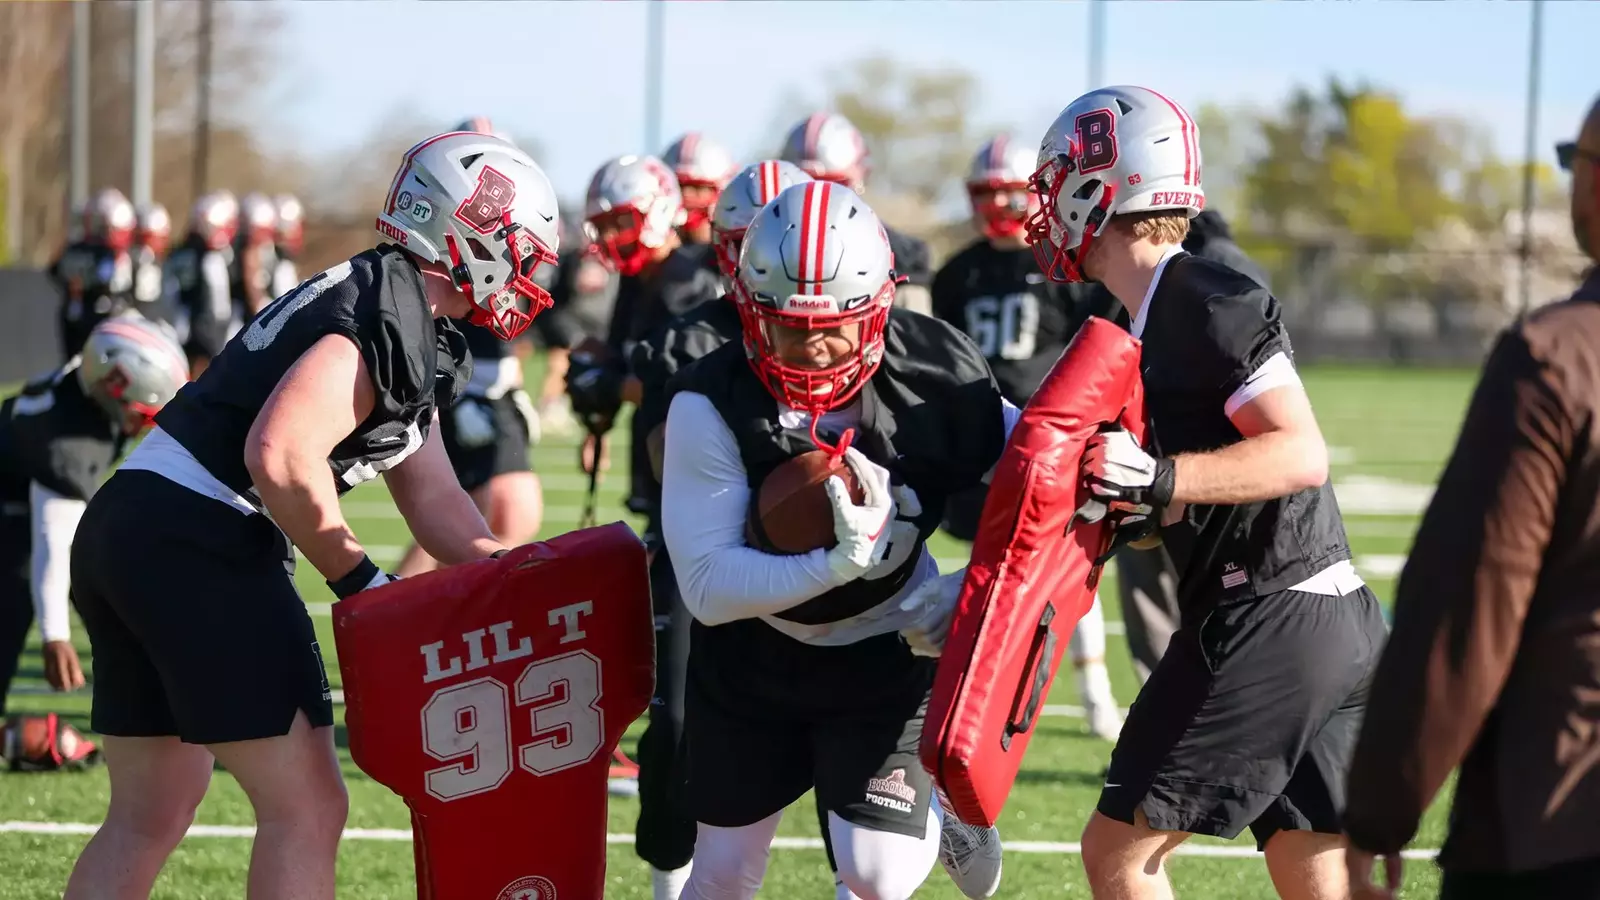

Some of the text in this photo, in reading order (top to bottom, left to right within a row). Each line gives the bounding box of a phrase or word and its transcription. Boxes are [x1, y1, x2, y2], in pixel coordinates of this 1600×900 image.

[1074, 108, 1118, 175] B
[1127, 173, 1142, 186] 63
[412, 203, 431, 219] BT
[453, 164, 516, 236] B
[1149, 191, 1192, 207] EVER
[380, 221, 409, 247] TRUE
[789, 299, 830, 309] Riddell
[965, 293, 1040, 360] 60
[1224, 561, 1238, 572] XL
[419, 600, 594, 684] LIL T
[420, 648, 606, 803] 93
[865, 793, 913, 814] FOOTBALL
[867, 778, 917, 806] BROWN
